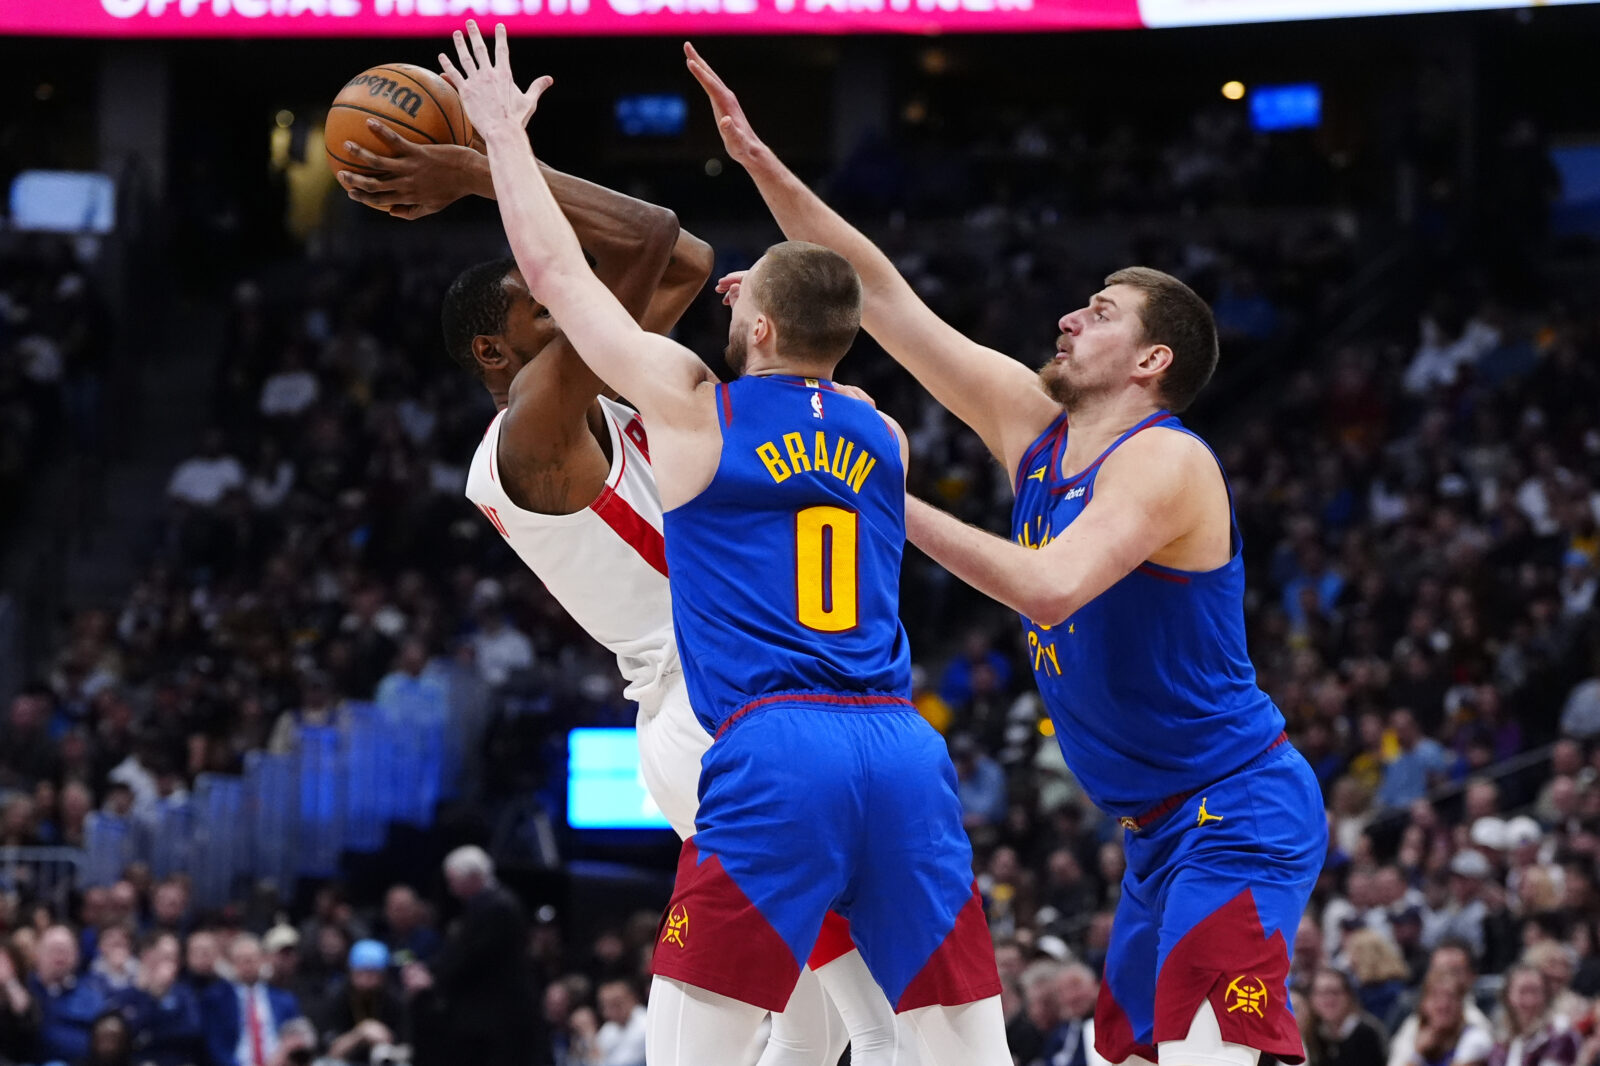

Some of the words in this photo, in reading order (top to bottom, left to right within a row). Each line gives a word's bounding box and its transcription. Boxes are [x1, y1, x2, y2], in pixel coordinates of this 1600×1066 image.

[344, 75, 424, 119] Wilson
[755, 431, 877, 494] BRAUN
[794, 505, 859, 634] 0
